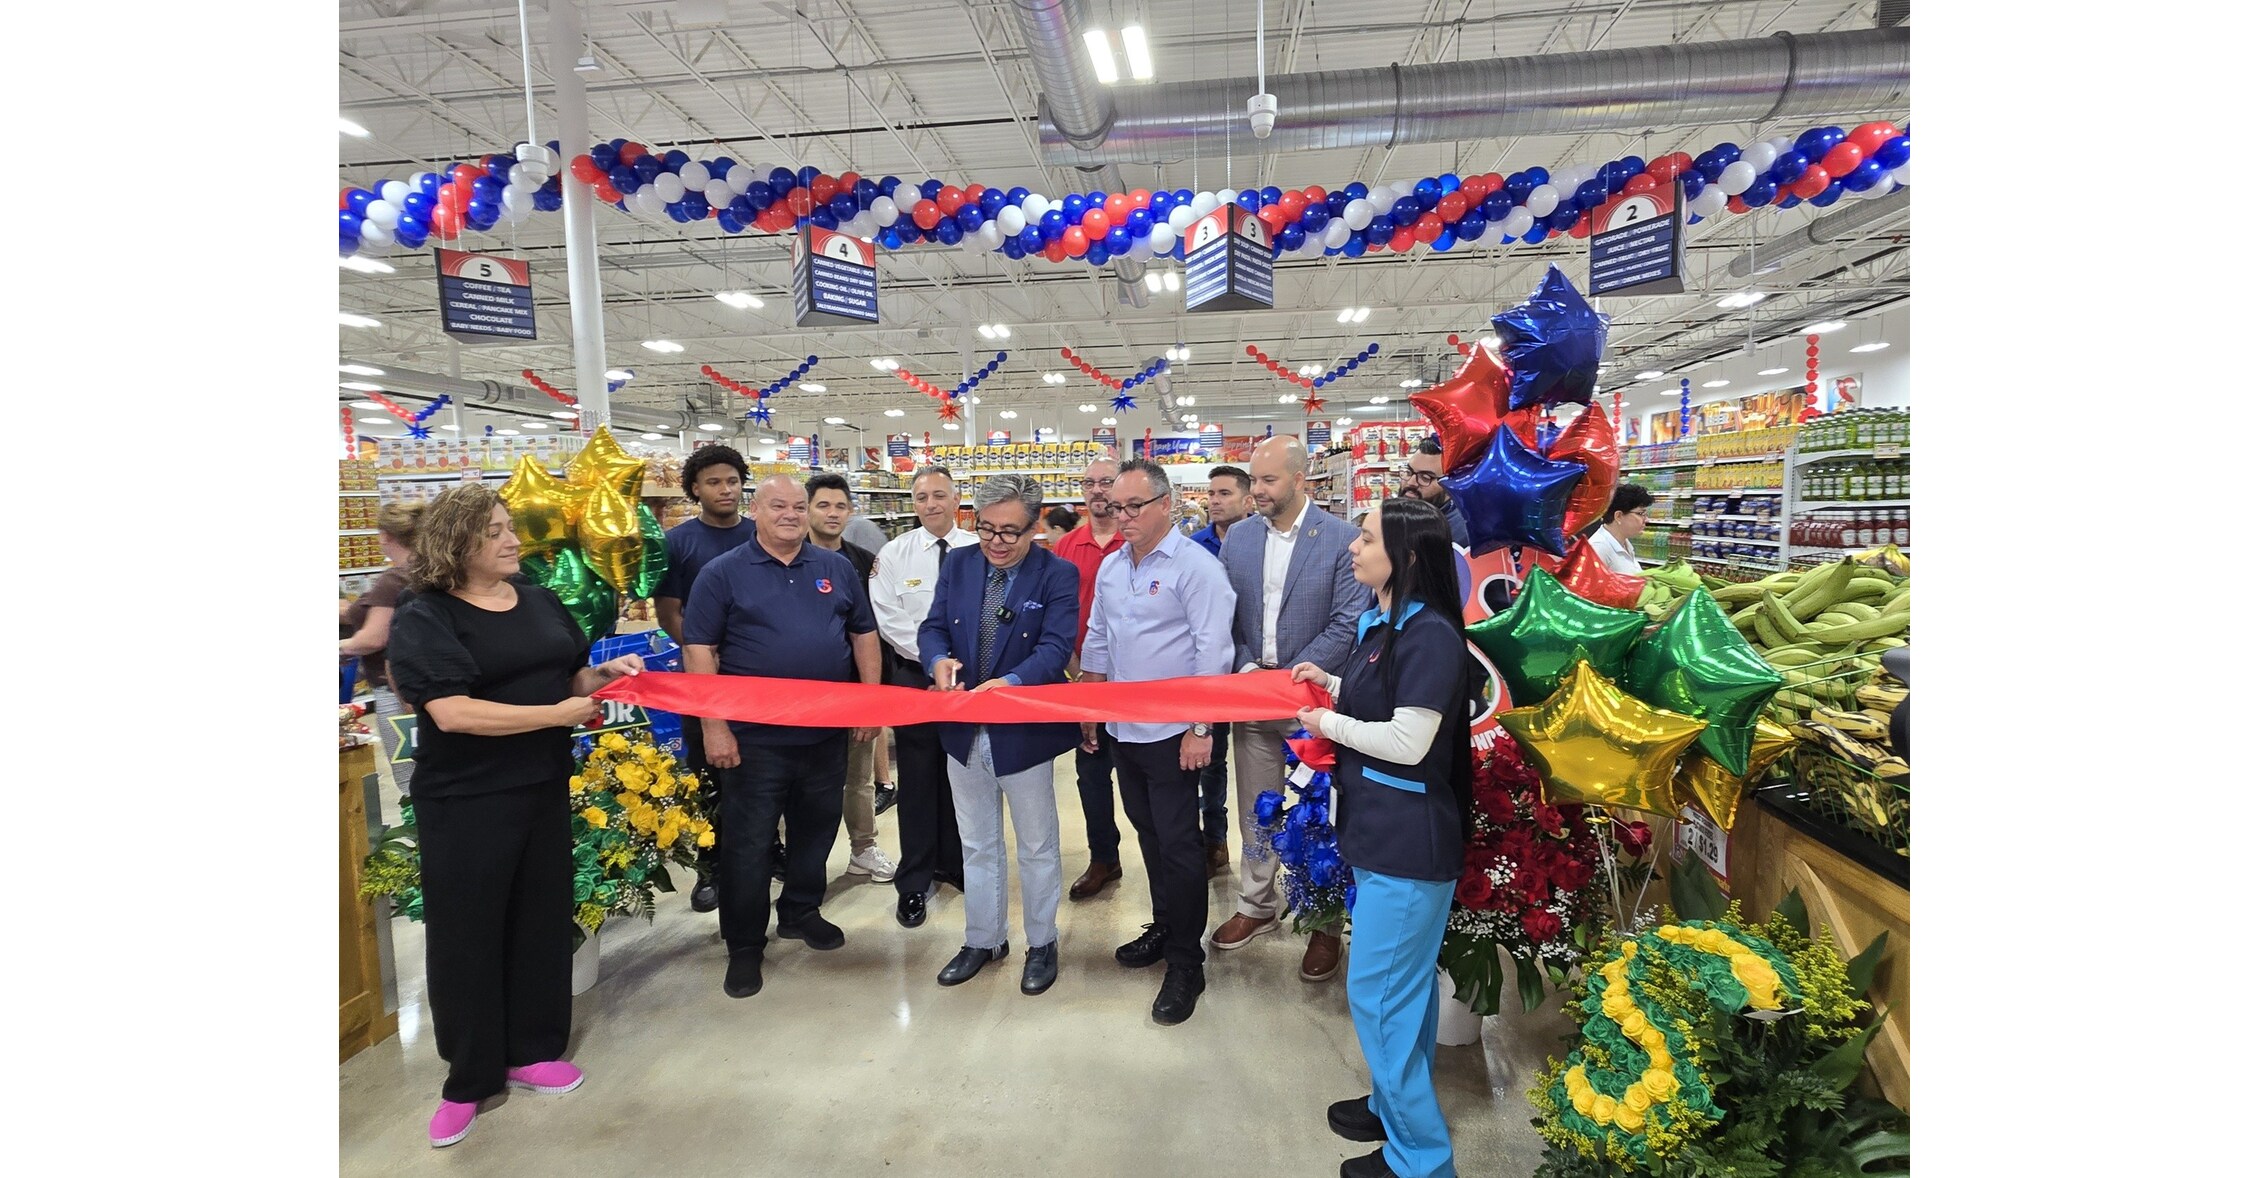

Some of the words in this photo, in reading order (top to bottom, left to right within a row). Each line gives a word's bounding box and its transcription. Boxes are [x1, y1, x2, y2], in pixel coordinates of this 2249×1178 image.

[1626, 205, 1637, 221] 2
[1203, 226, 1208, 240] 3
[1250, 222, 1256, 238] 3
[1594, 231, 1628, 245] GATORADE
[1633, 219, 1670, 234] POWERADE
[840, 243, 848, 257] 4
[1607, 243, 1625, 254] JUICE
[1630, 235, 1656, 248] NECTAR
[813, 258, 834, 269] CANNED
[1593, 257, 1617, 269] CANNED
[480, 264, 492, 277] 5
[814, 269, 833, 279] CANNED
[463, 281, 491, 291] COFFEE
[497, 286, 512, 294] TEA
[815, 280, 838, 291] COOKING
[851, 286, 865, 296] OLIVE
[866, 290, 874, 298] OIL
[1598, 279, 1618, 289] CANDY
[462, 292, 494, 302] CANNED
[496, 296, 515, 305] MILK
[823, 292, 845, 303] BAKING
[848, 297, 867, 307] SUGAR
[450, 301, 477, 310] CEREAL
[482, 304, 513, 315] PANCAKE
[469, 314, 513, 324] CHOCOLATE
[469, 323, 492, 331] NEEDS
[496, 326, 513, 334] BABY
[514, 327, 532, 335] FOOD
[1150, 440, 1171, 453] Thank
[1687, 828, 1695, 845] 2
[1699, 835, 1719, 863] $1.29
